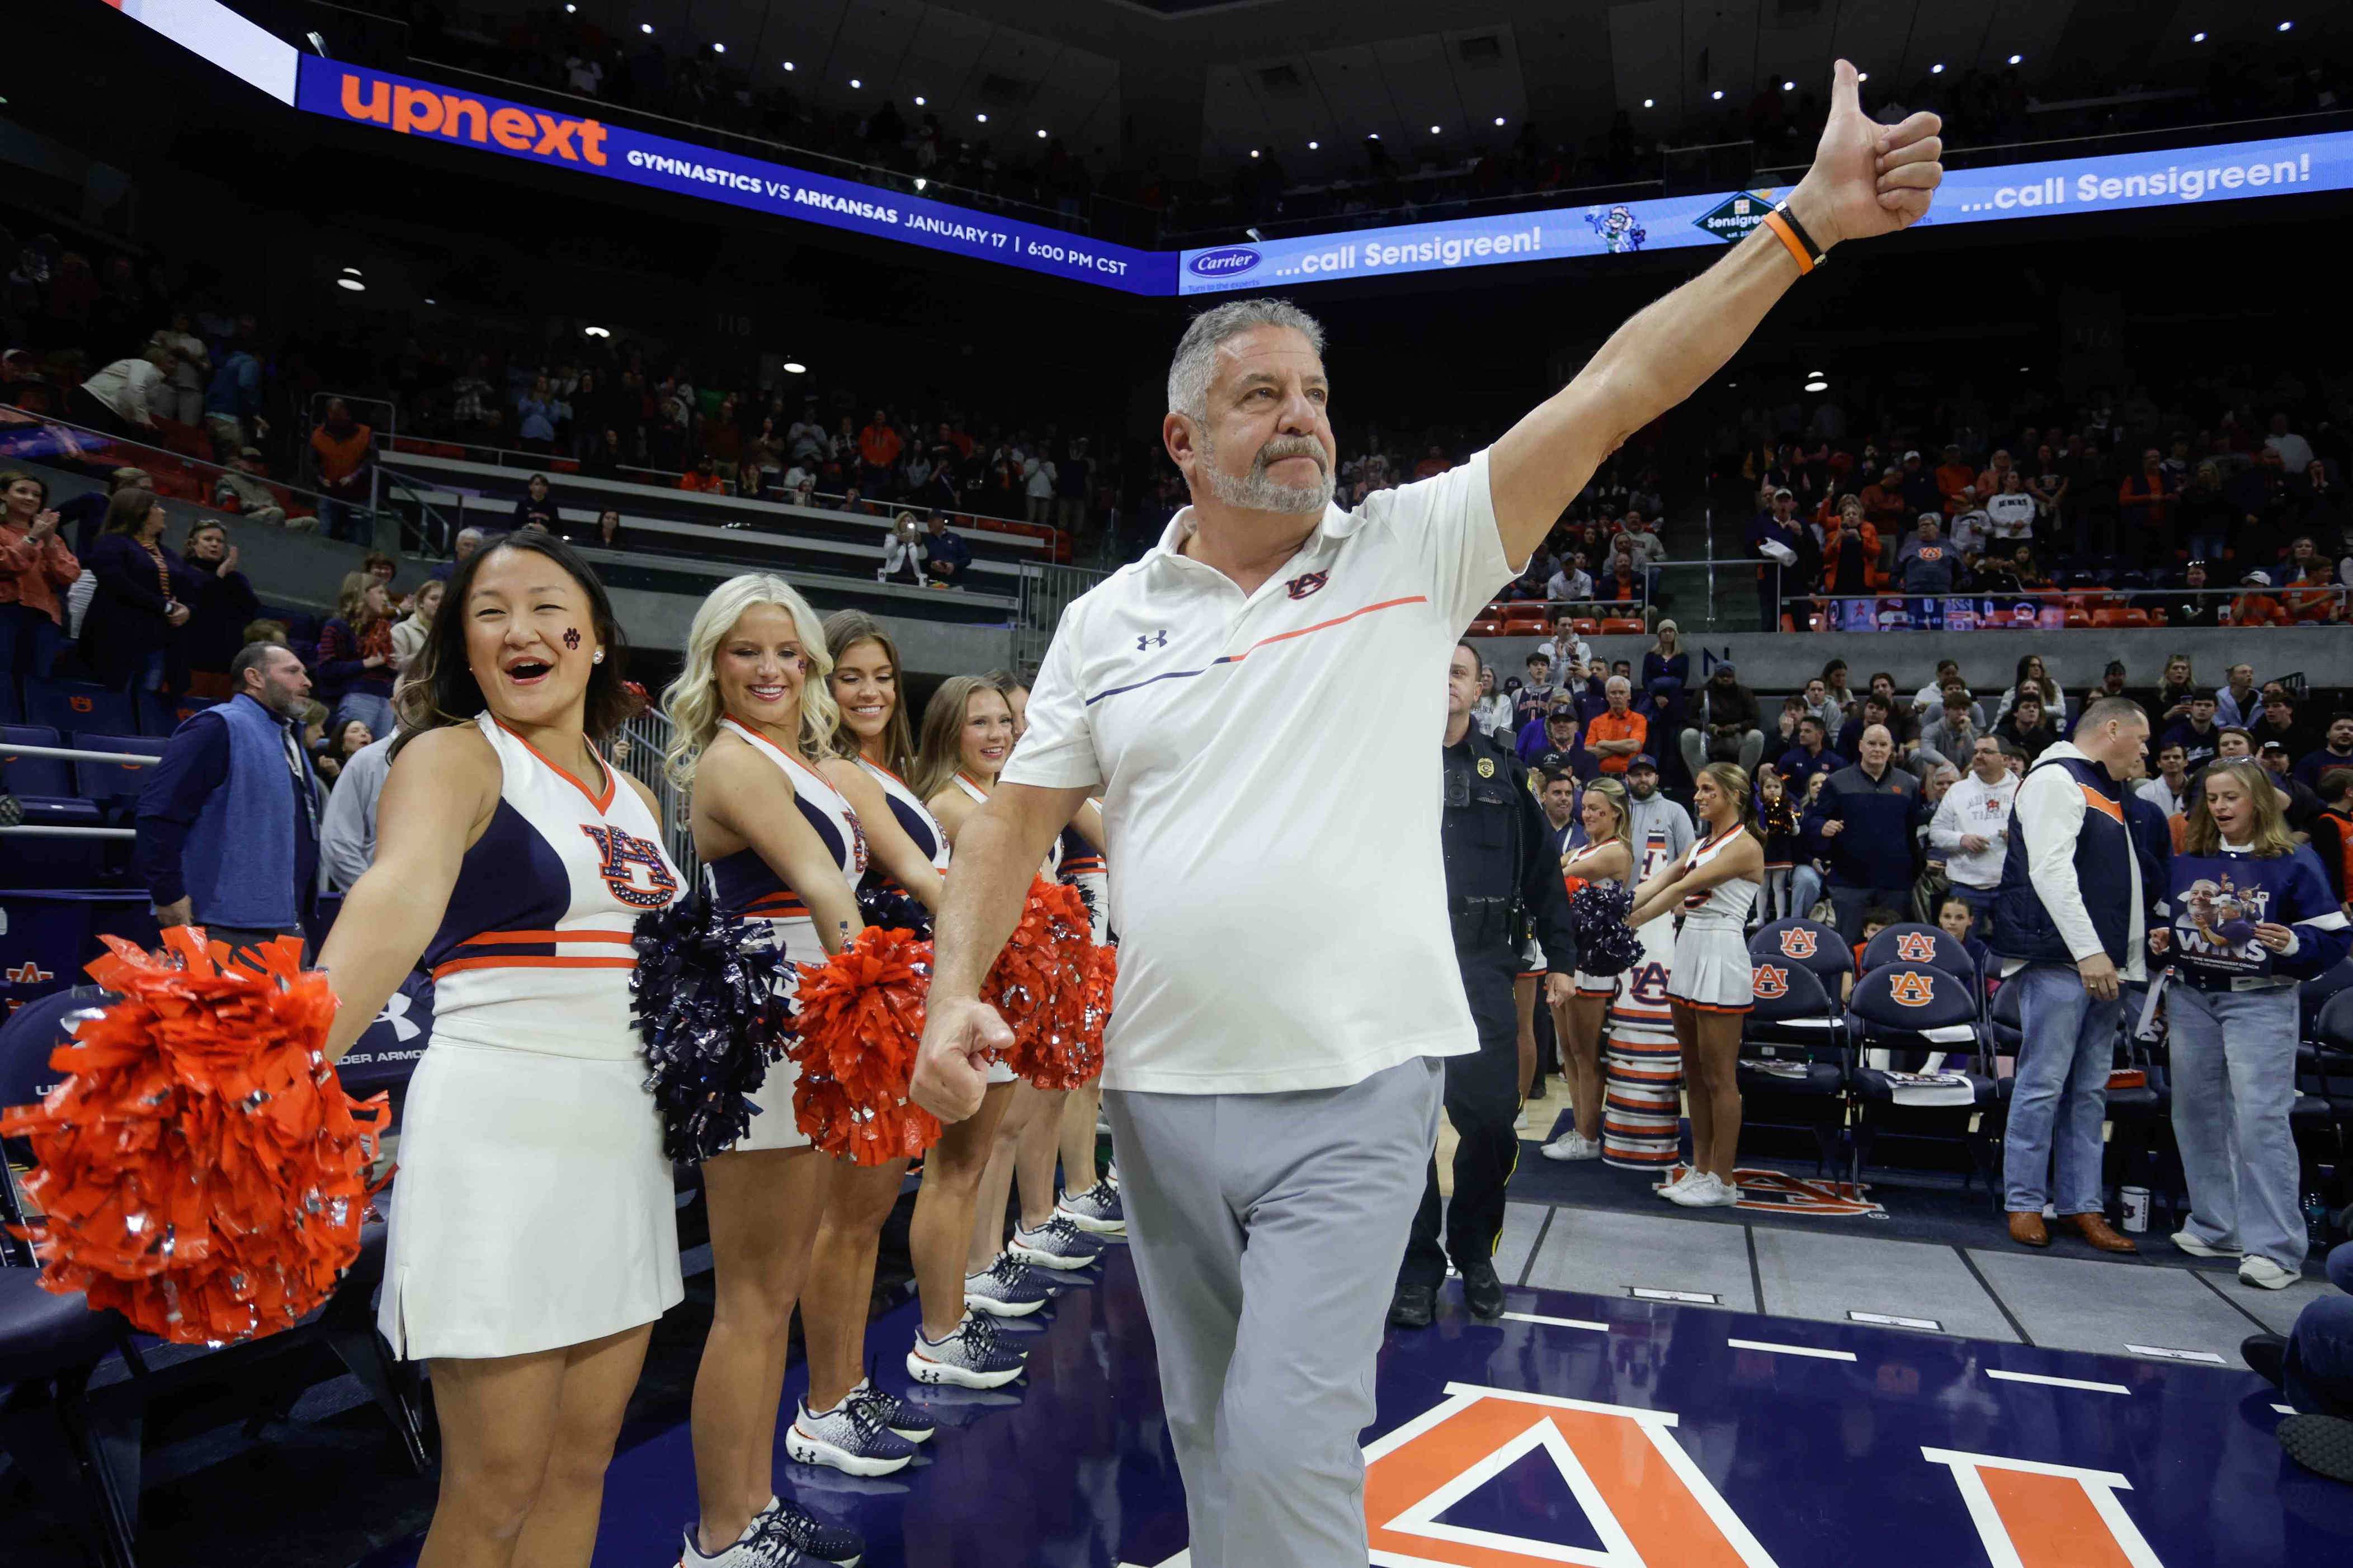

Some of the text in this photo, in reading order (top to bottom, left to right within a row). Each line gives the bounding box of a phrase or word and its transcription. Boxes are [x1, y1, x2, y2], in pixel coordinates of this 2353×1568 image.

[341, 74, 607, 167] upnext
[1961, 153, 2310, 212] ...call Sensigreen!
[627, 150, 762, 193] GYMNASTICS
[766, 181, 790, 200] VS
[794, 188, 898, 223] ARKANSAS
[904, 214, 988, 243] JANUARY
[991, 233, 1007, 247] 17
[1028, 242, 1064, 261] 6:00
[1068, 250, 1092, 268] PM
[1097, 258, 1127, 275] CST
[1197, 253, 1253, 271] Carrier
[1276, 227, 1541, 276] ...call Sensigreen!
[1285, 569, 1329, 601] AU
[578, 823, 679, 909] AU
[1780, 926, 1817, 959] AU
[1897, 931, 1936, 964] AU
[1889, 970, 1934, 1008] AU
